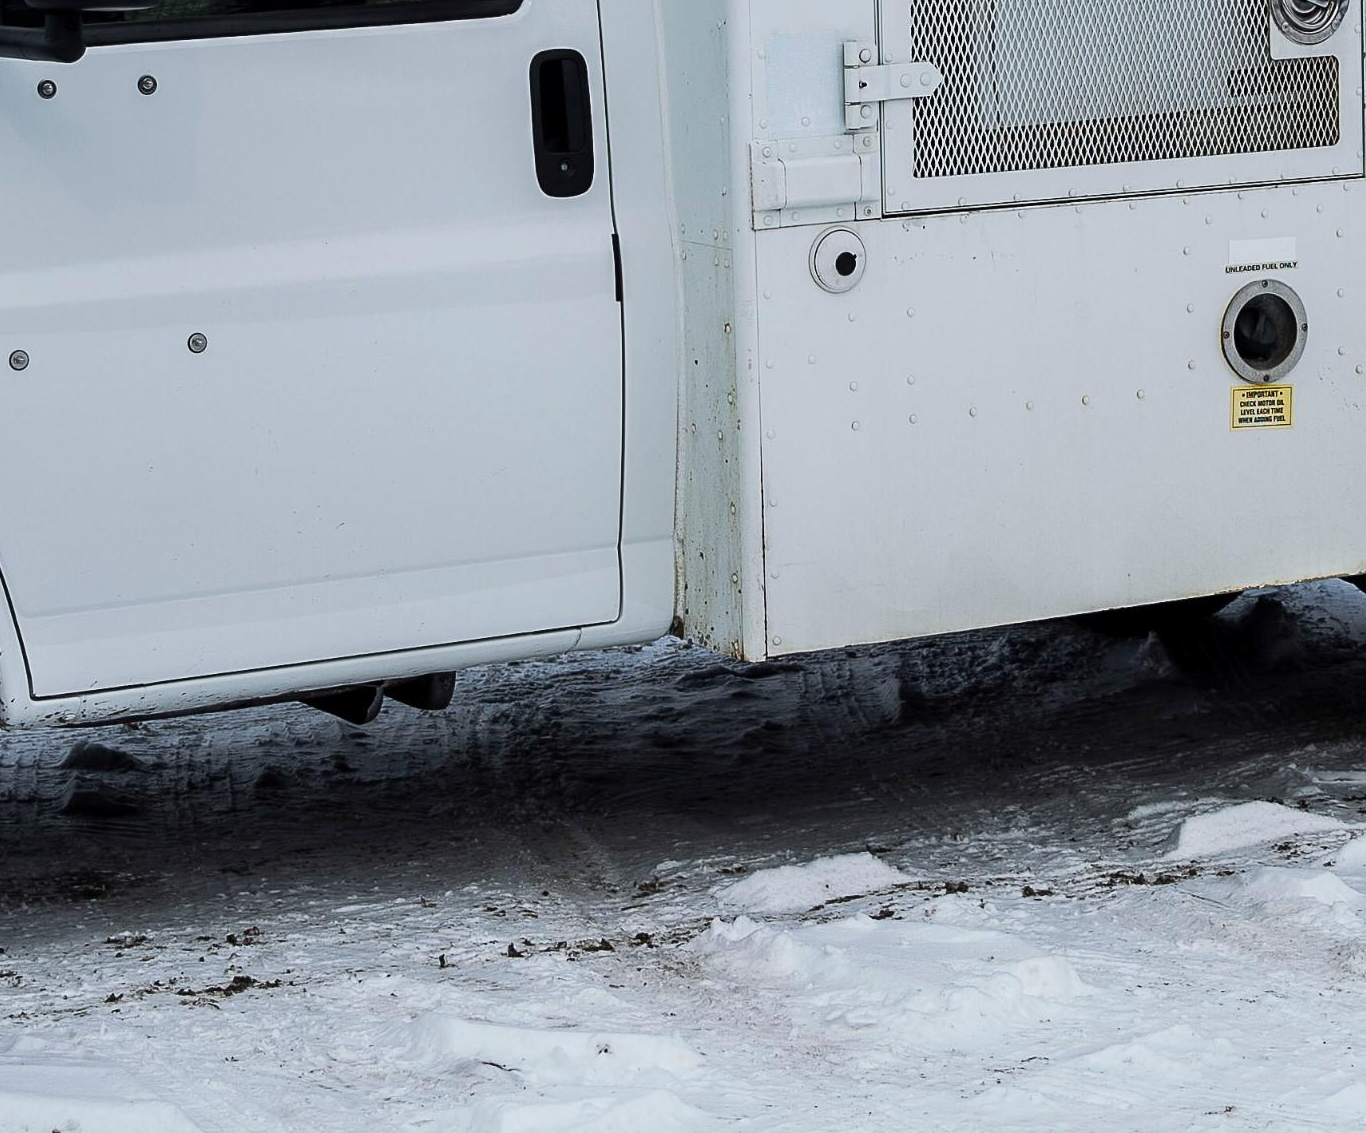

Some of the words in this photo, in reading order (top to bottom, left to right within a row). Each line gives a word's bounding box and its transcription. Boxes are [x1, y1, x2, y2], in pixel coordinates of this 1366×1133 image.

[1225, 264, 1260, 274] UNLEADED
[1279, 261, 1298, 269] ONLY
[1246, 390, 1278, 398] IMPORTANT
